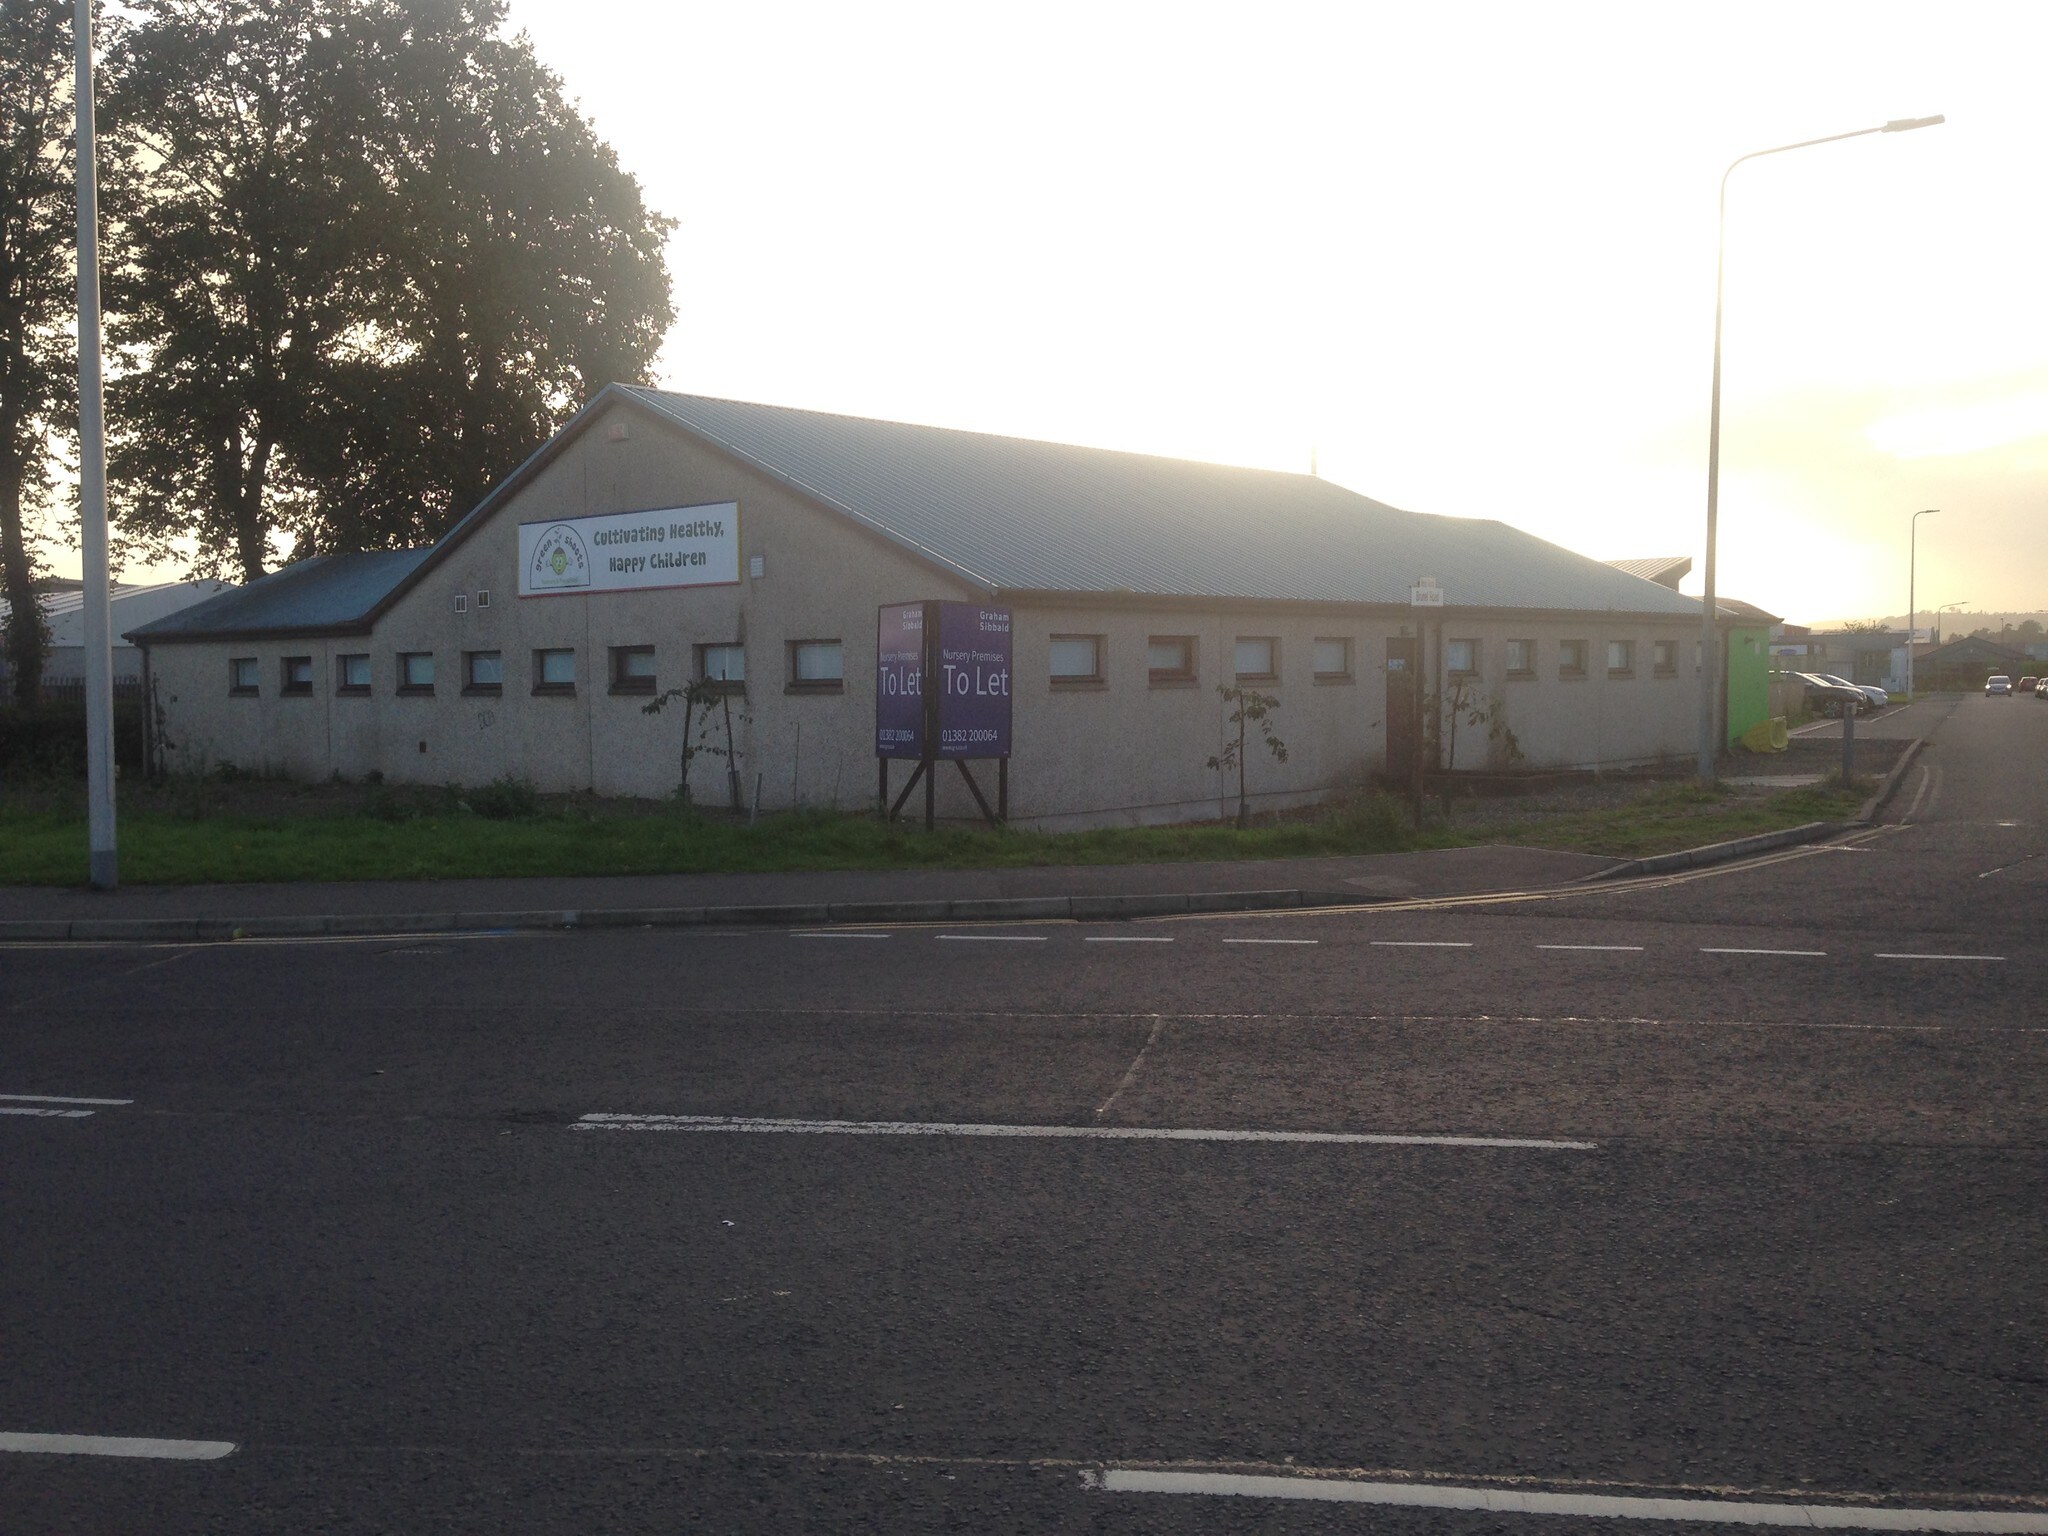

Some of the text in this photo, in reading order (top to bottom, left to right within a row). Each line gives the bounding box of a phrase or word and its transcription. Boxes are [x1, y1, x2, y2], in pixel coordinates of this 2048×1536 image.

[594, 521, 724, 546] Cultivating Healthy,
[536, 536, 584, 572] green shoots
[610, 551, 706, 573] Happy Children
[902, 610, 922, 619] Graham
[980, 611, 1009, 622] Graham
[902, 620, 922, 630] Sibbald
[980, 622, 1009, 632] Sibbald
[943, 649, 1004, 663] Nursery Premises
[880, 666, 922, 696] To Let
[943, 665, 1008, 696] To Let
[942, 729, 998, 742] 01382 200064
